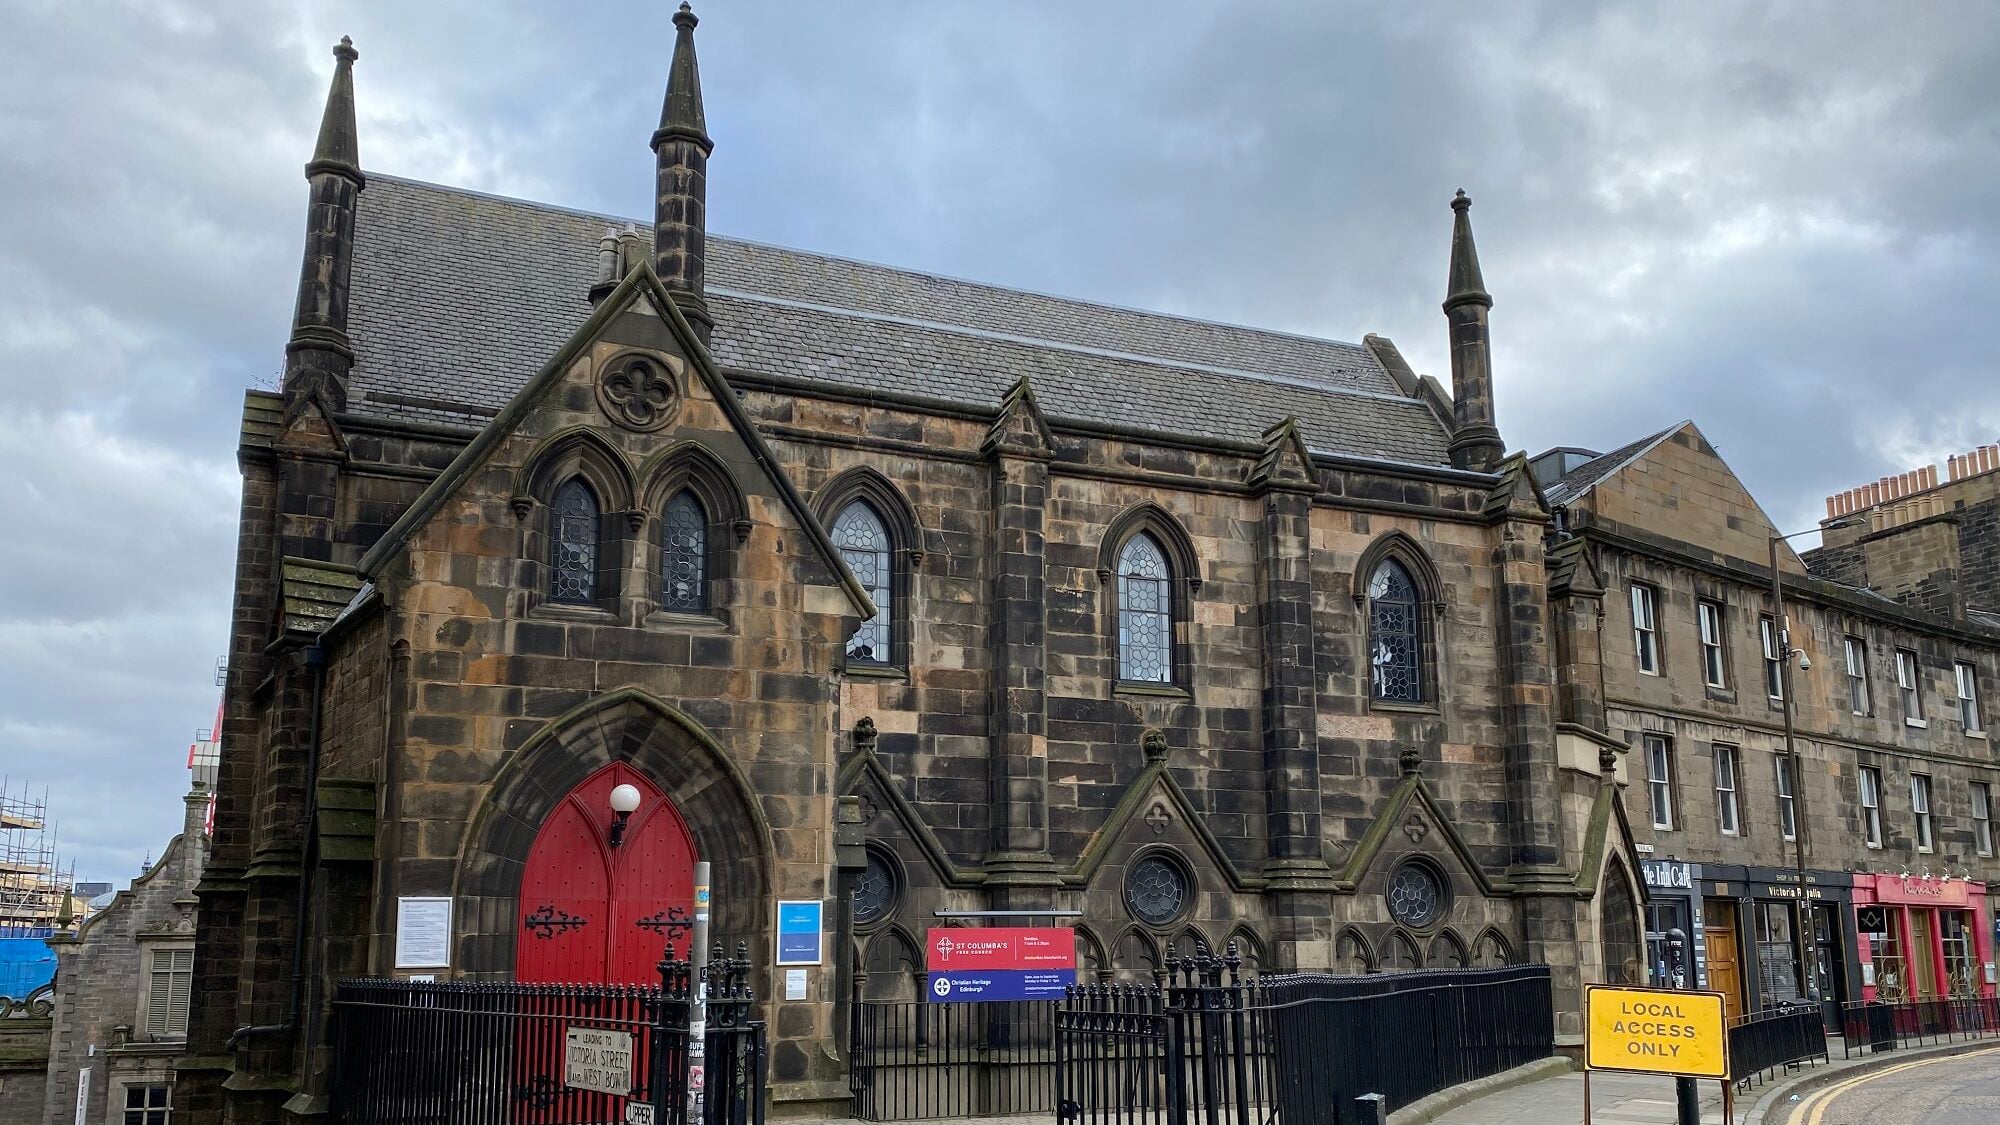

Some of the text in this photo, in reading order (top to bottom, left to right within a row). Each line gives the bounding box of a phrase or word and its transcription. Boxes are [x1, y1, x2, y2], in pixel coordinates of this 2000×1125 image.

[1655, 865, 1671, 886] Inn
[1768, 886, 1796, 898] Victoria
[956, 942, 1008, 950] ST COLUMBA'S
[1621, 1001, 1686, 1019] LOCAL
[1613, 1020, 1696, 1039] ACCESS
[582, 1034, 612, 1046] LEADING TO
[568, 1046, 630, 1069] VICTORIA STREET
[1627, 1041, 1681, 1058] ONLY
[583, 1068, 602, 1087] WEST
[605, 1070, 623, 1089] BOW
[629, 1102, 652, 1125] UPPER
